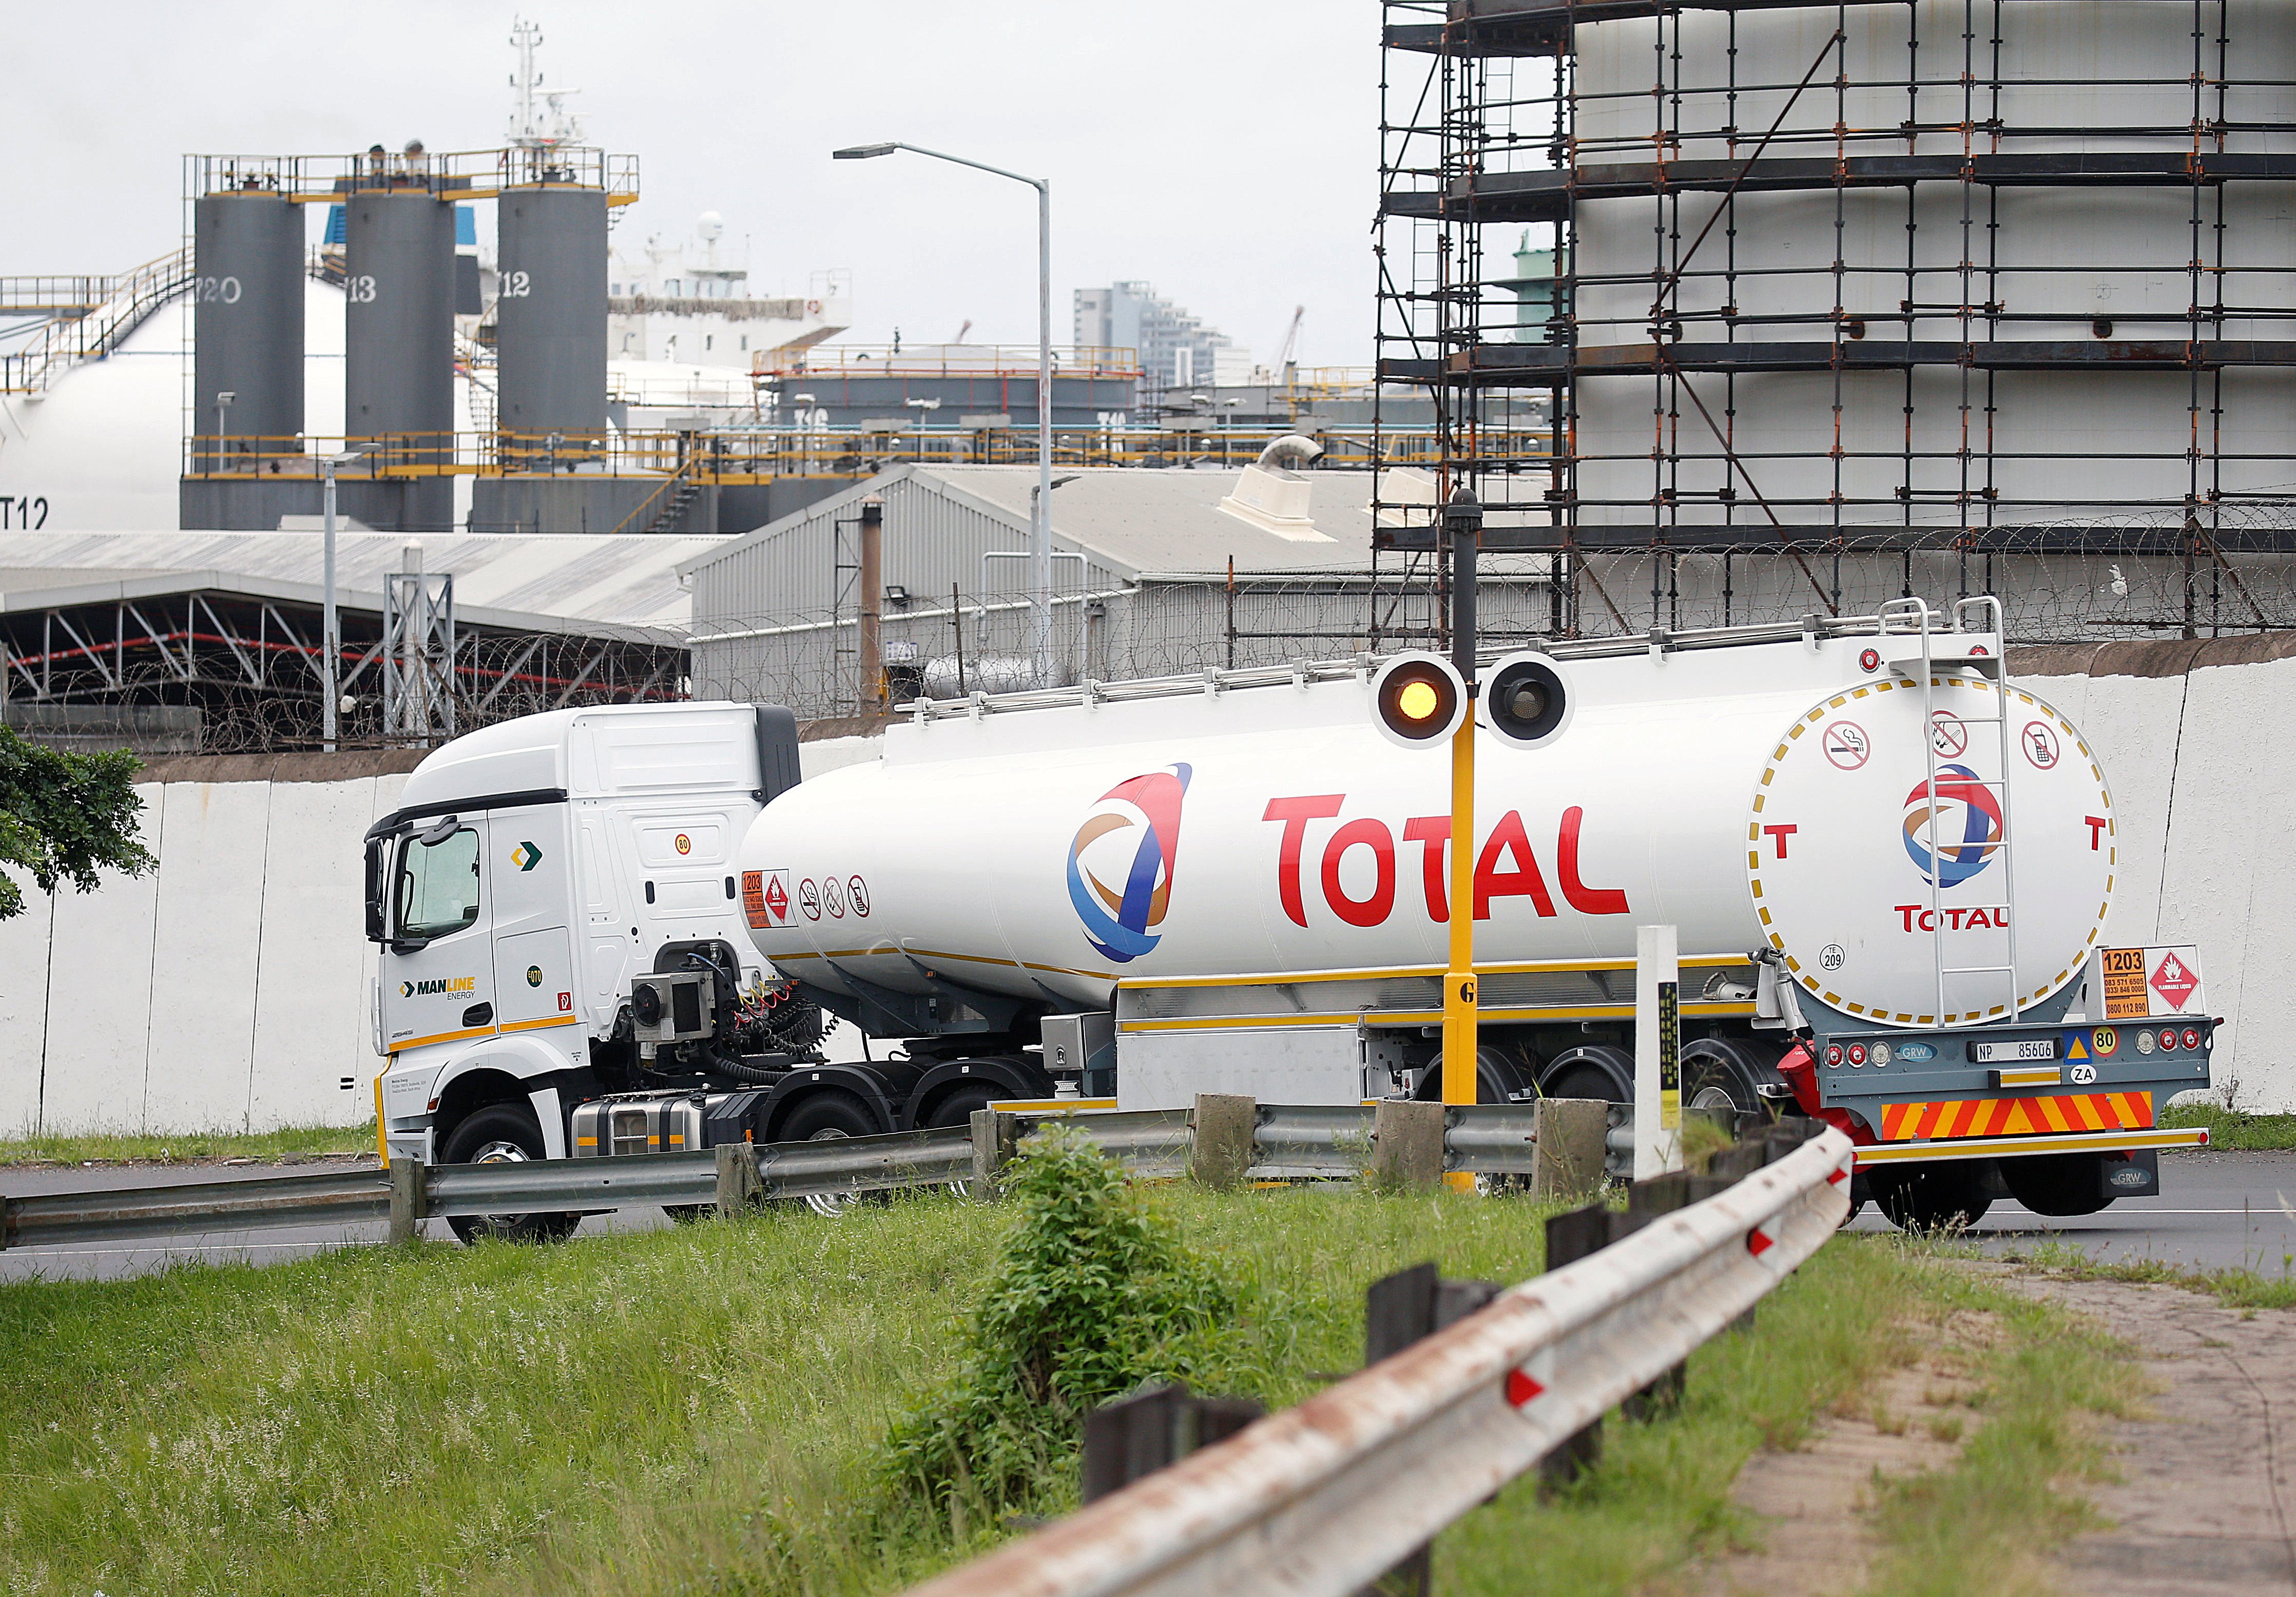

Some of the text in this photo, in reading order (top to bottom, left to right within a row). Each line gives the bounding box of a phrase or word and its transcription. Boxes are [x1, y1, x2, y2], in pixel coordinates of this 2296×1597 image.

[344, 275, 376, 303] 13
[0, 496, 48, 530] T12
[1764, 824, 1798, 859] T
[2085, 815, 2106, 851] T
[679, 839, 687, 849] 80
[1262, 793, 1631, 929] TOTAL
[743, 874, 761, 890] 1203
[1894, 905, 2009, 933] TOTAL
[1825, 954, 1841, 967] 209
[2105, 952, 2143, 971] 1203
[417, 976, 475, 995] MANLINE
[447, 991, 475, 1000] ENERGY
[2107, 1003, 2146, 1014] 0800 112 890
[1665, 987, 1673, 1085] PETROLEUM
[2096, 1032, 2114, 1048] 80
[1902, 1047, 1926, 1057] GRW
[1979, 1043, 2052, 1060] NP 85606
[2074, 1068, 2093, 1081] ZA
[2118, 1172, 2141, 1183] GRW
